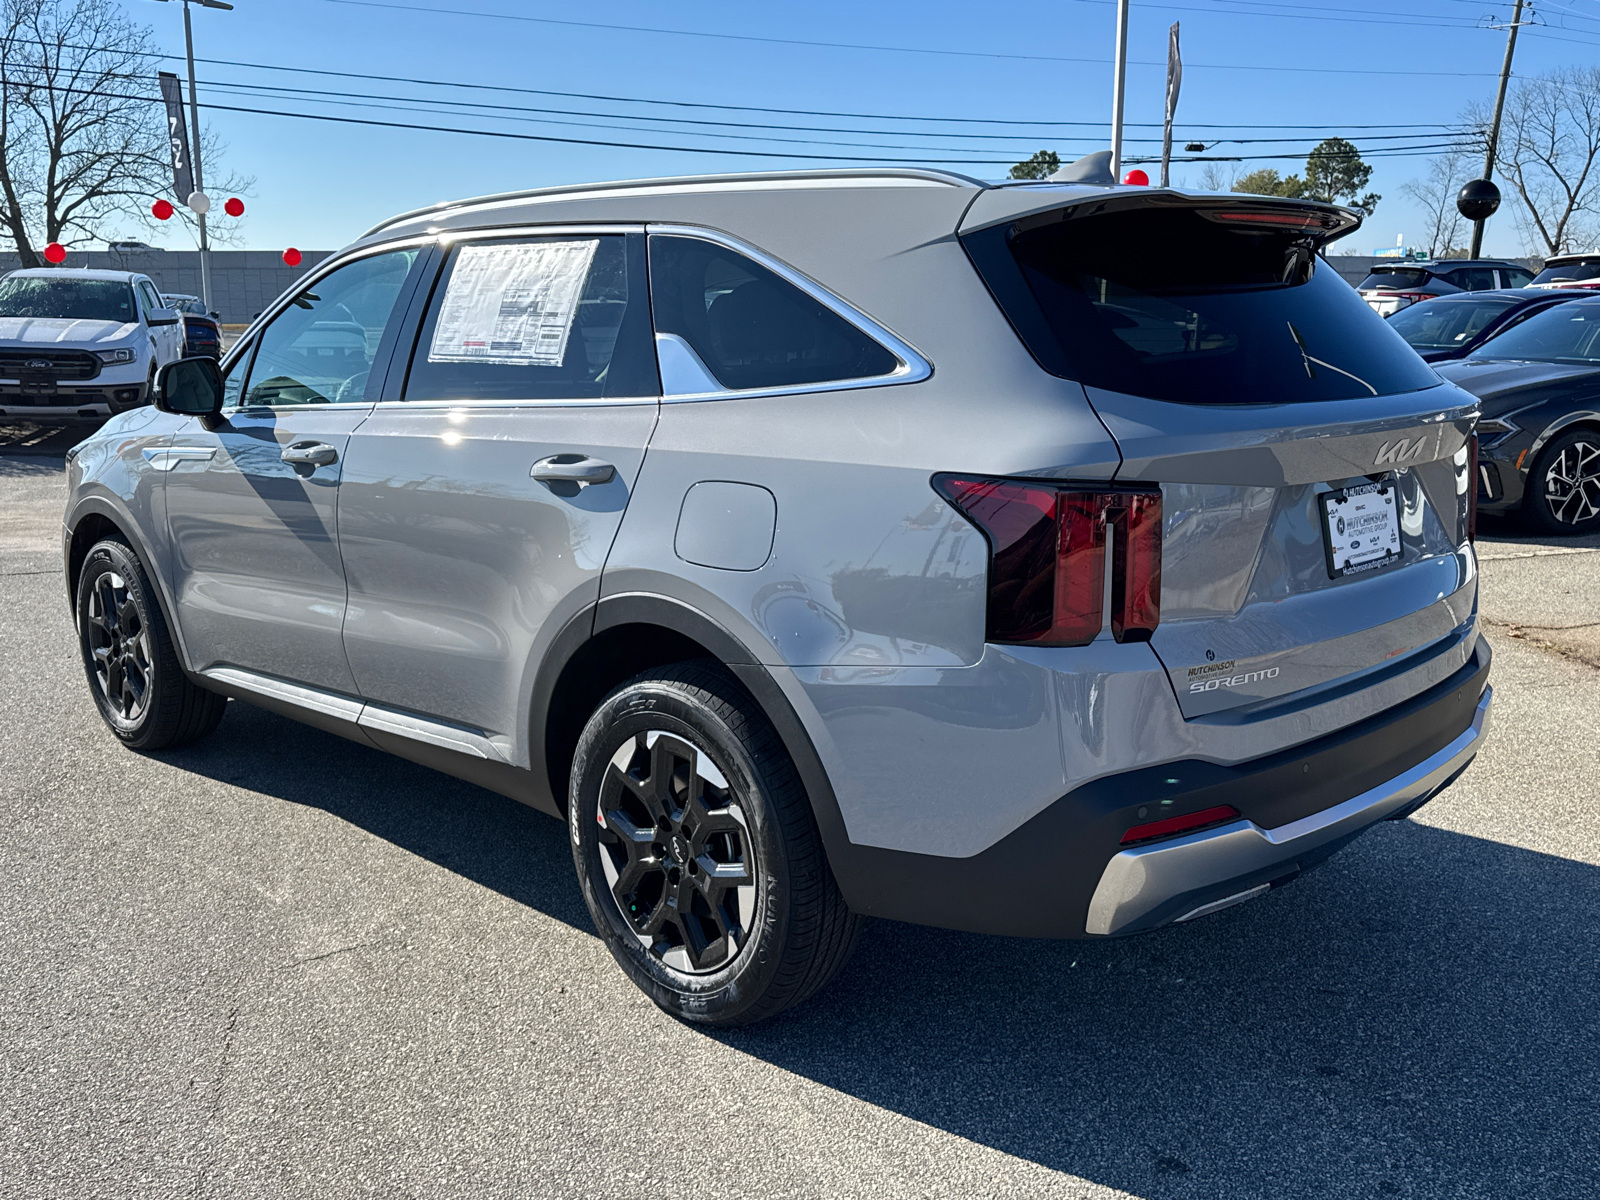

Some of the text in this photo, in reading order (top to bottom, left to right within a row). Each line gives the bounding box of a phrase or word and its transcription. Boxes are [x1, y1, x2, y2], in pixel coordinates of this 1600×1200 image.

[1372, 434, 1428, 466] KIA
[1349, 483, 1382, 498] HUTCHINSON
[1346, 510, 1389, 531] HUTCHINSON
[1348, 522, 1388, 538] AUTOMOTIVE GROUP
[1188, 660, 1236, 677] HUTCHINSON
[1189, 669, 1234, 682] AUTOMOTIVE GROUP
[1189, 666, 1280, 694] SORENTO
